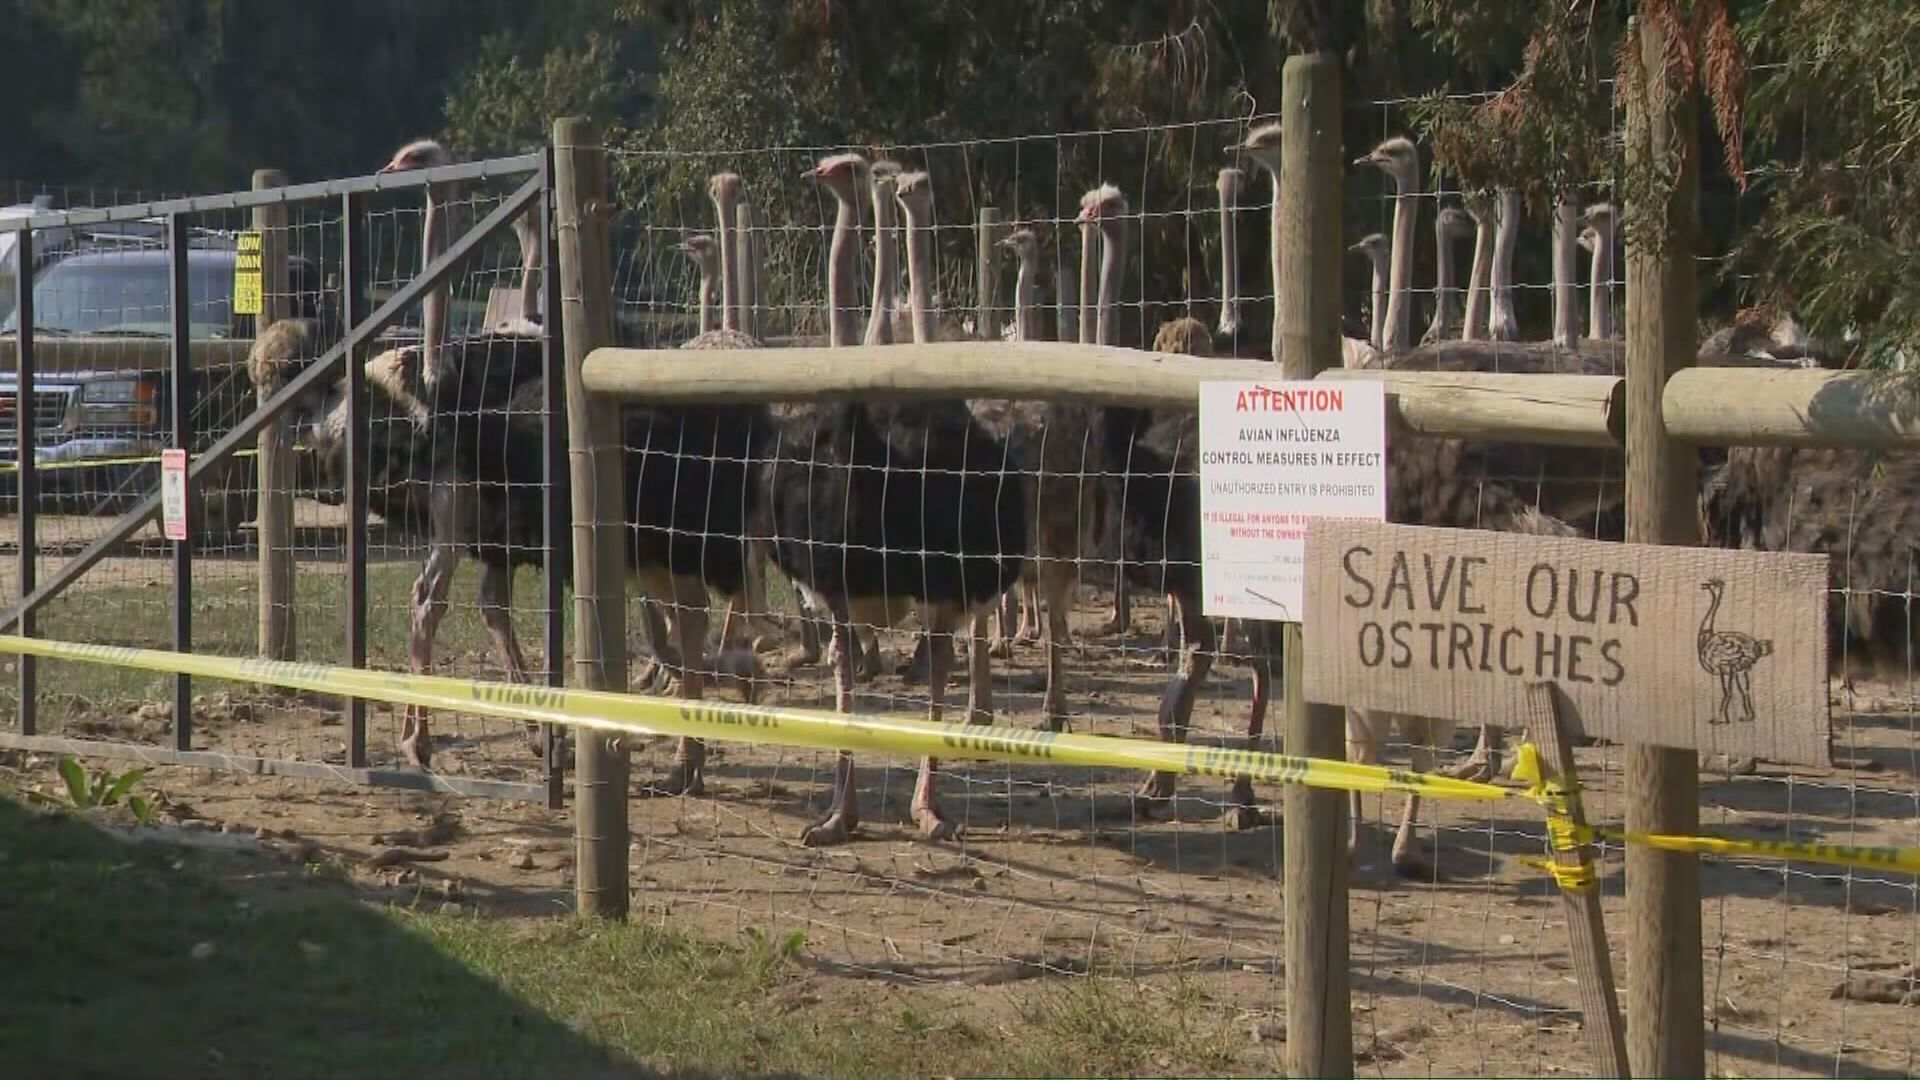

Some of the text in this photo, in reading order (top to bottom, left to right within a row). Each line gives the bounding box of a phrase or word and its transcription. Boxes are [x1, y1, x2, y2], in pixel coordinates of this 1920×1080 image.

[1236, 389, 1343, 412] ATTENTION
[1239, 428, 1340, 443] AVIAN INFLUENZA
[1202, 451, 1381, 467] CONTROL MEASURES IN EFFECT
[1210, 481, 1375, 497] UNAUTHORIZED ENTRY IS PROHIBITED
[1262, 514, 1289, 525] ANYONE
[1342, 545, 1641, 627] SAVE OUR
[1358, 620, 1626, 687] OSTRICHES
